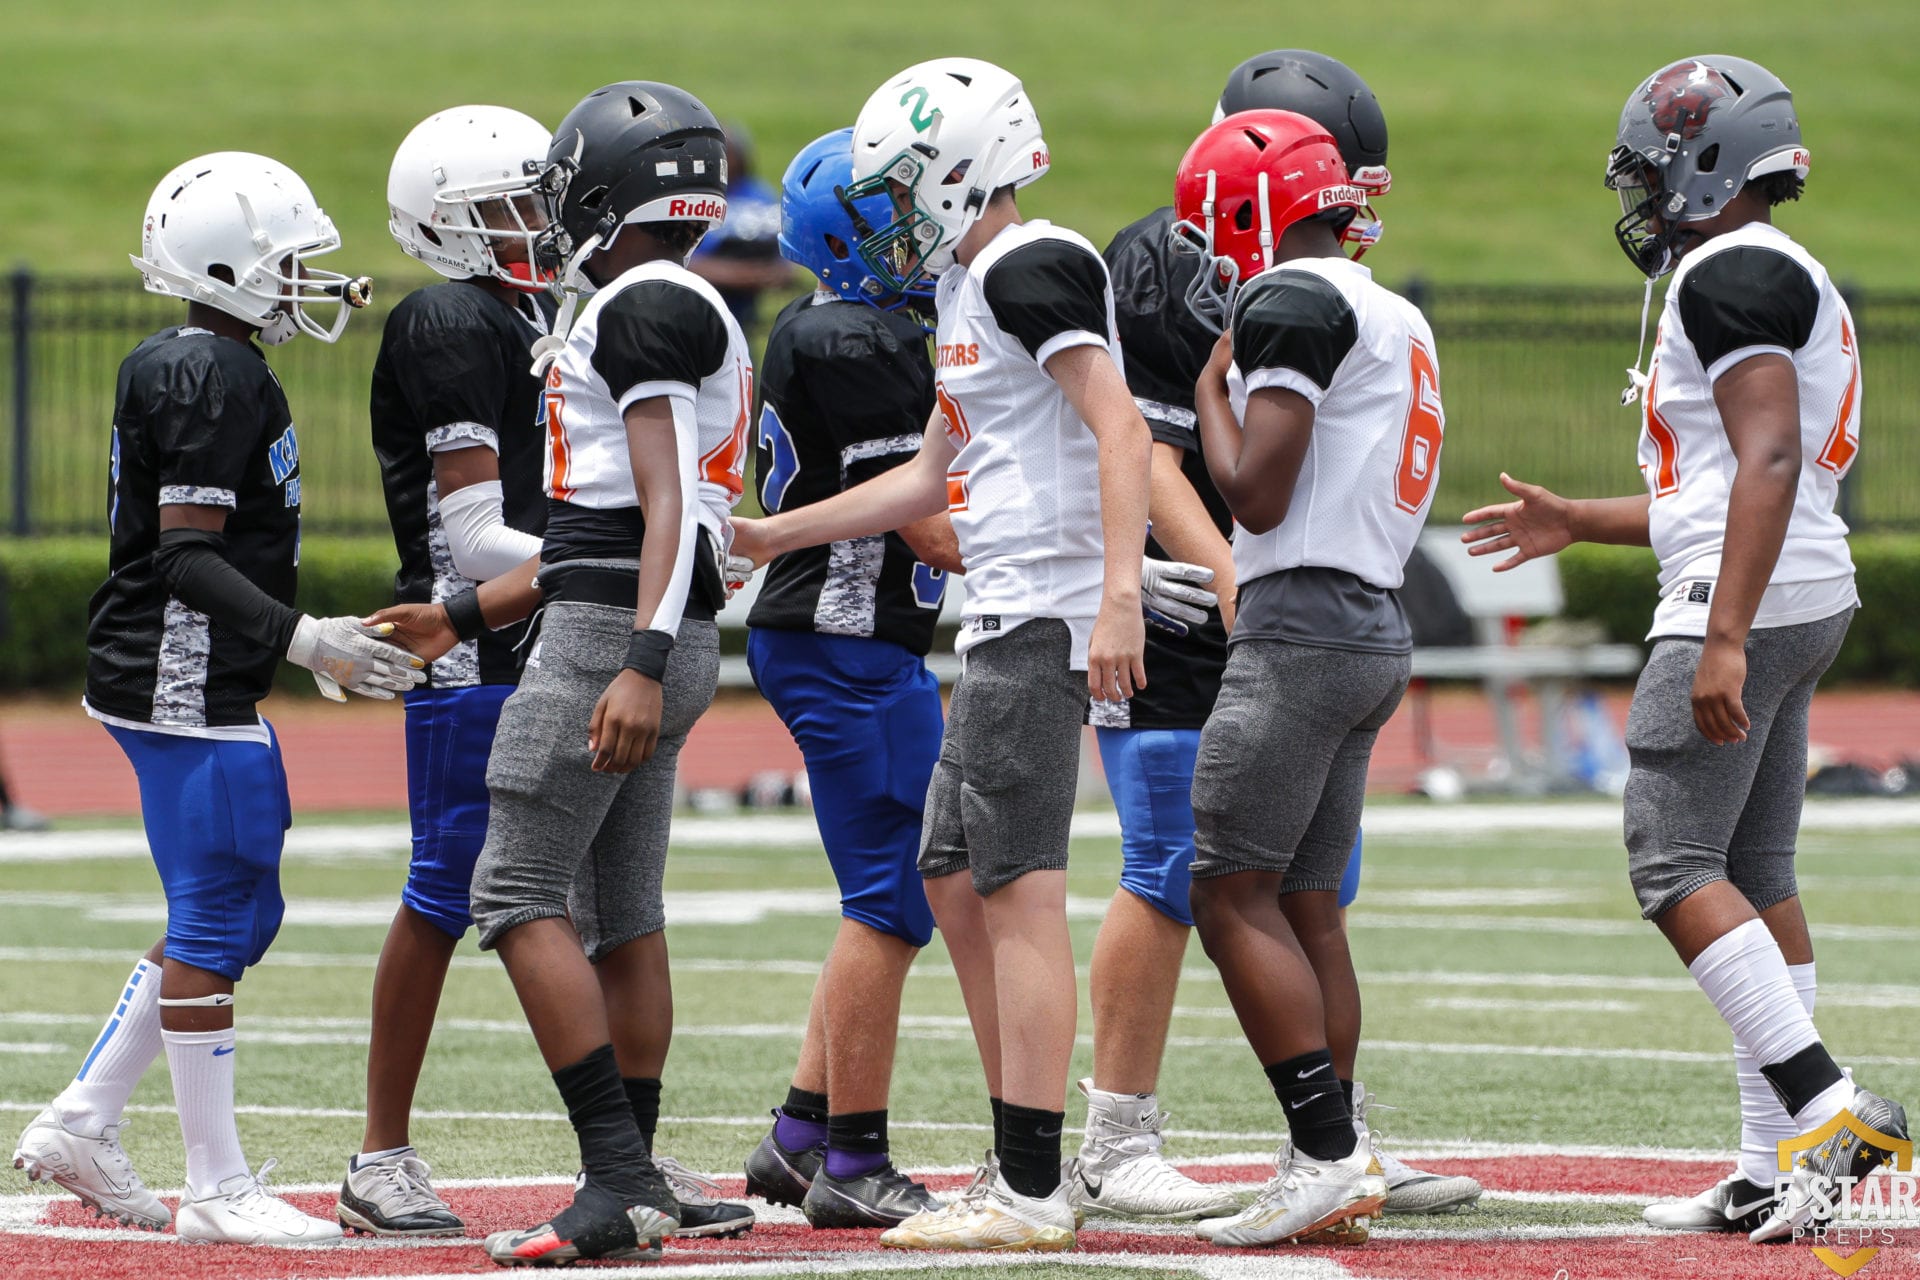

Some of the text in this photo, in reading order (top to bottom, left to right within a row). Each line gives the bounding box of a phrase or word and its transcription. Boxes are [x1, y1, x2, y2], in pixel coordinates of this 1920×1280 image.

[899, 86, 944, 133] 2
[1322, 187, 1364, 205] Riddell
[436, 255, 466, 270] ADAMS
[1393, 335, 1443, 516] 6
